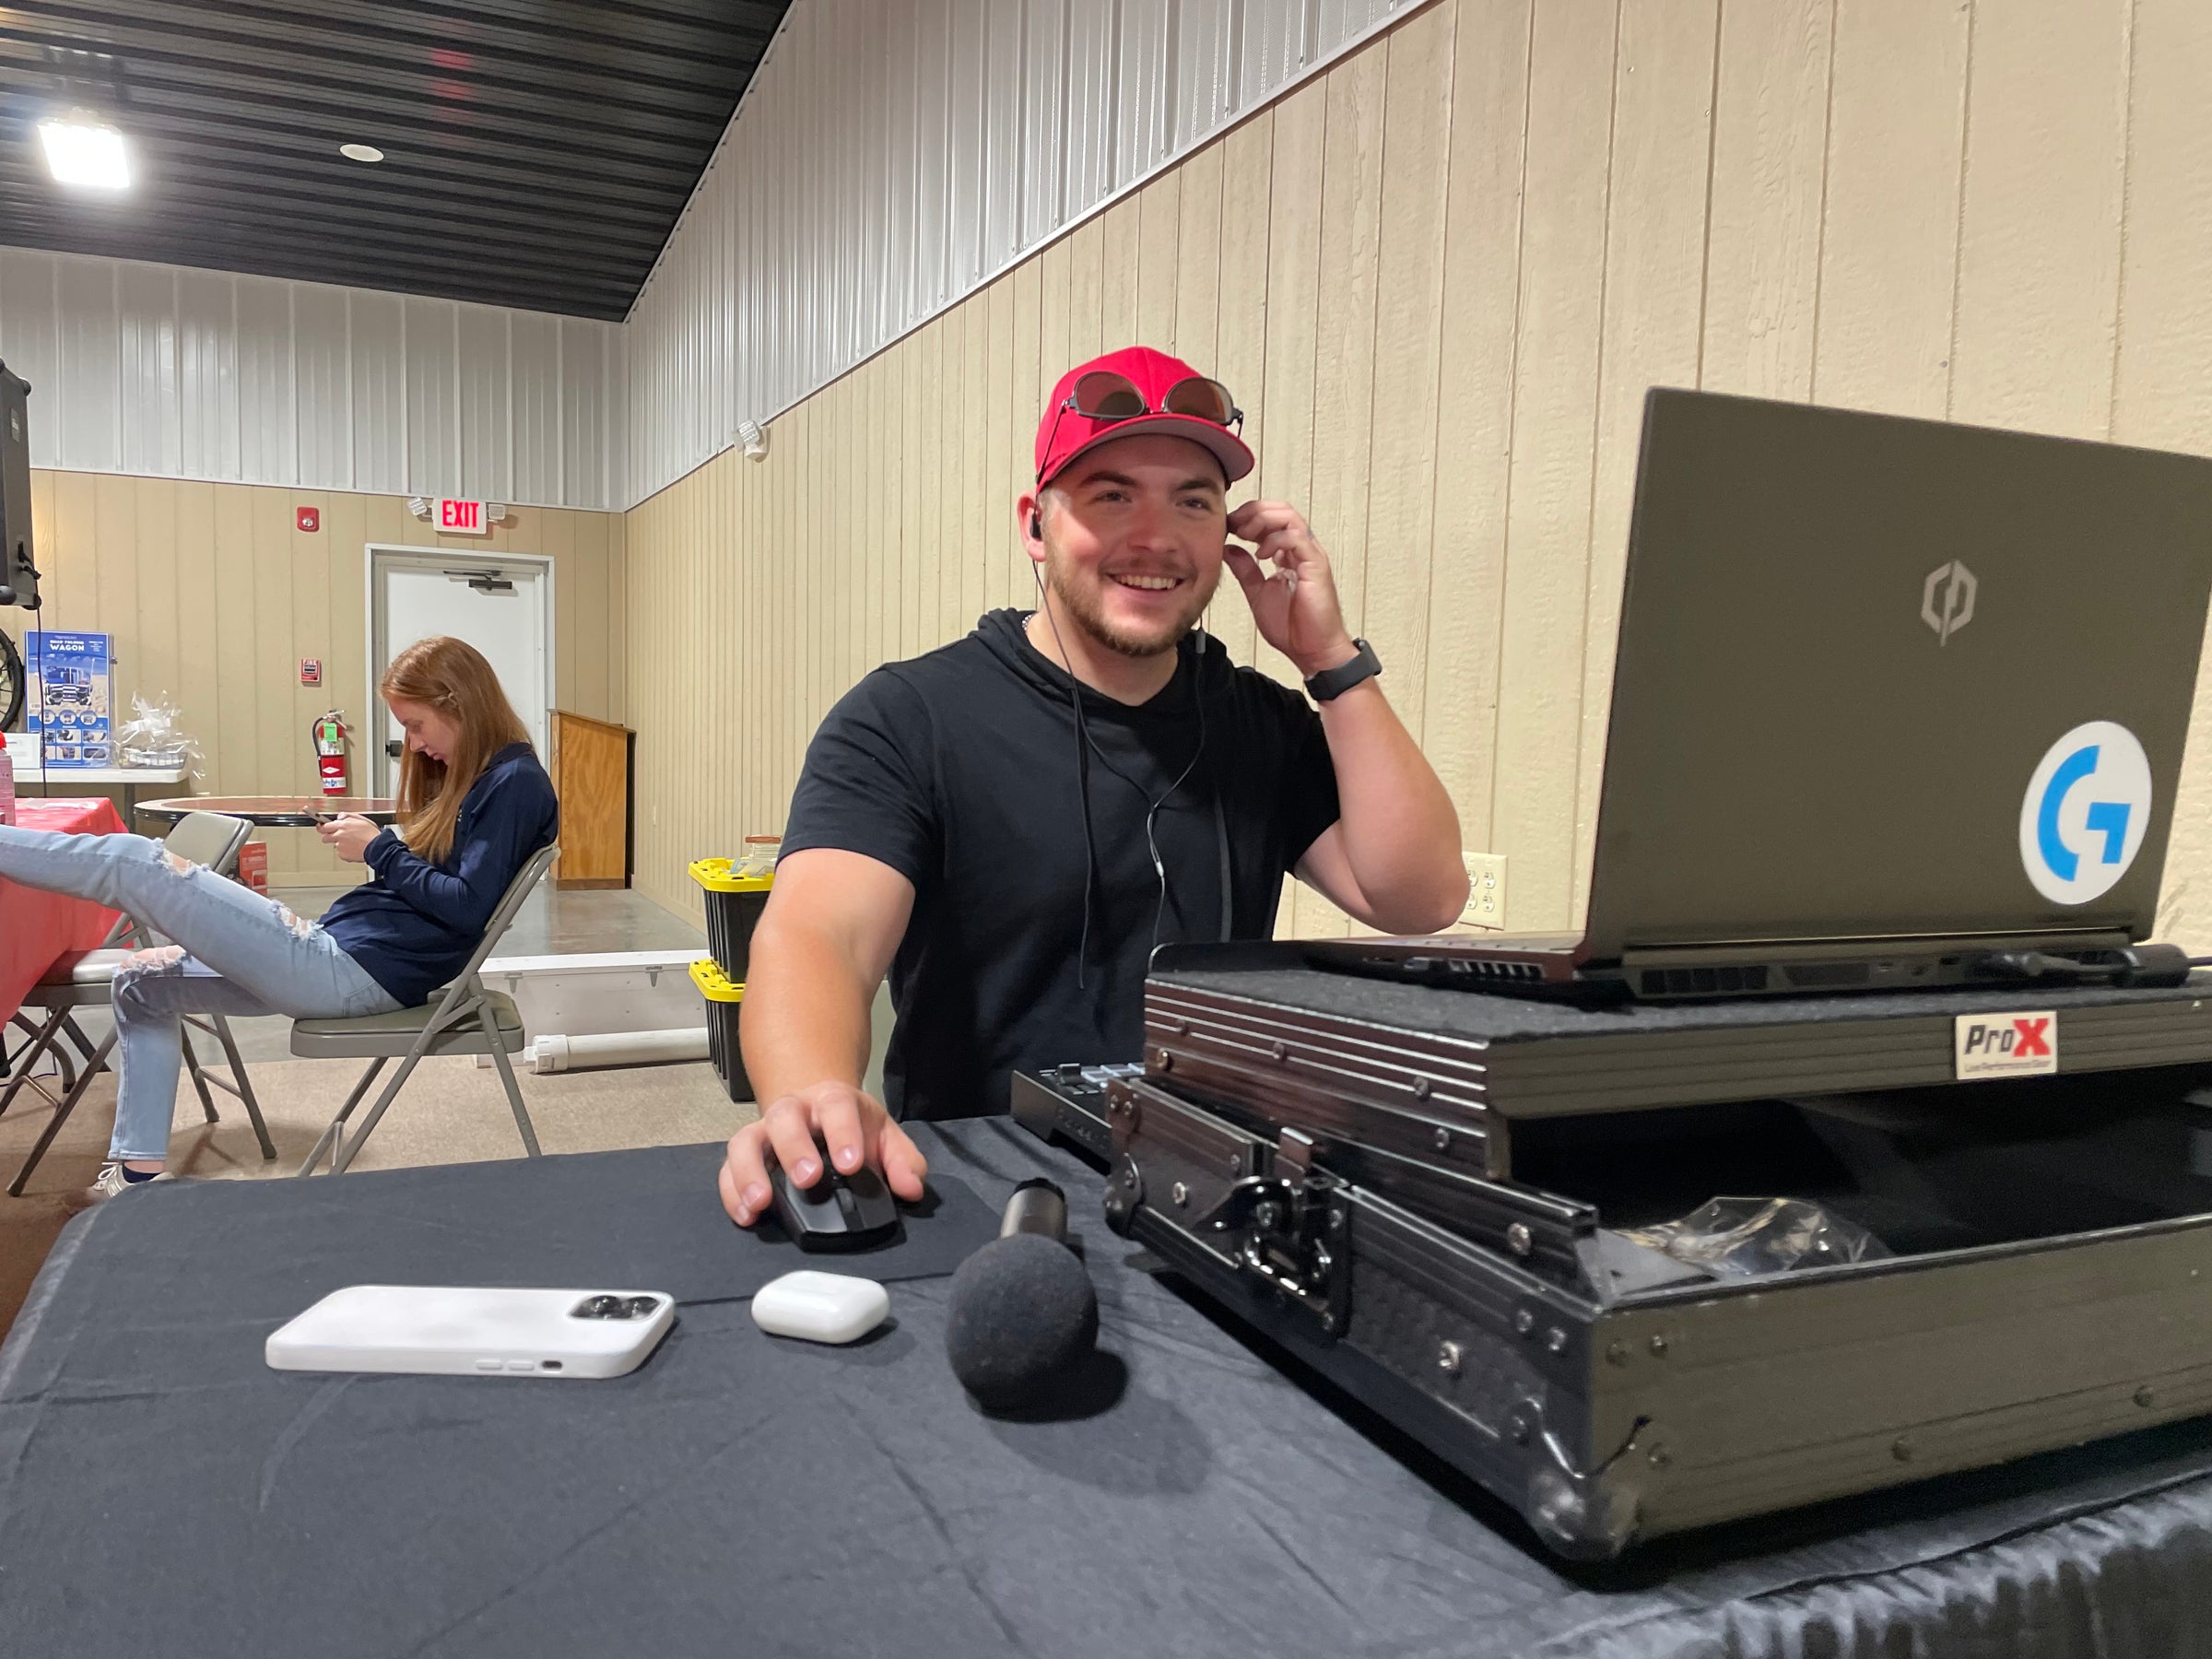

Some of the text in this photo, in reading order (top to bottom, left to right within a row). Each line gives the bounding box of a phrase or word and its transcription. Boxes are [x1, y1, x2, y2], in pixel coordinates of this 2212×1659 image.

[442, 500, 479, 528] EXIT
[49, 643, 85, 652] WAGON
[1964, 1018, 2051, 1057] ProX
